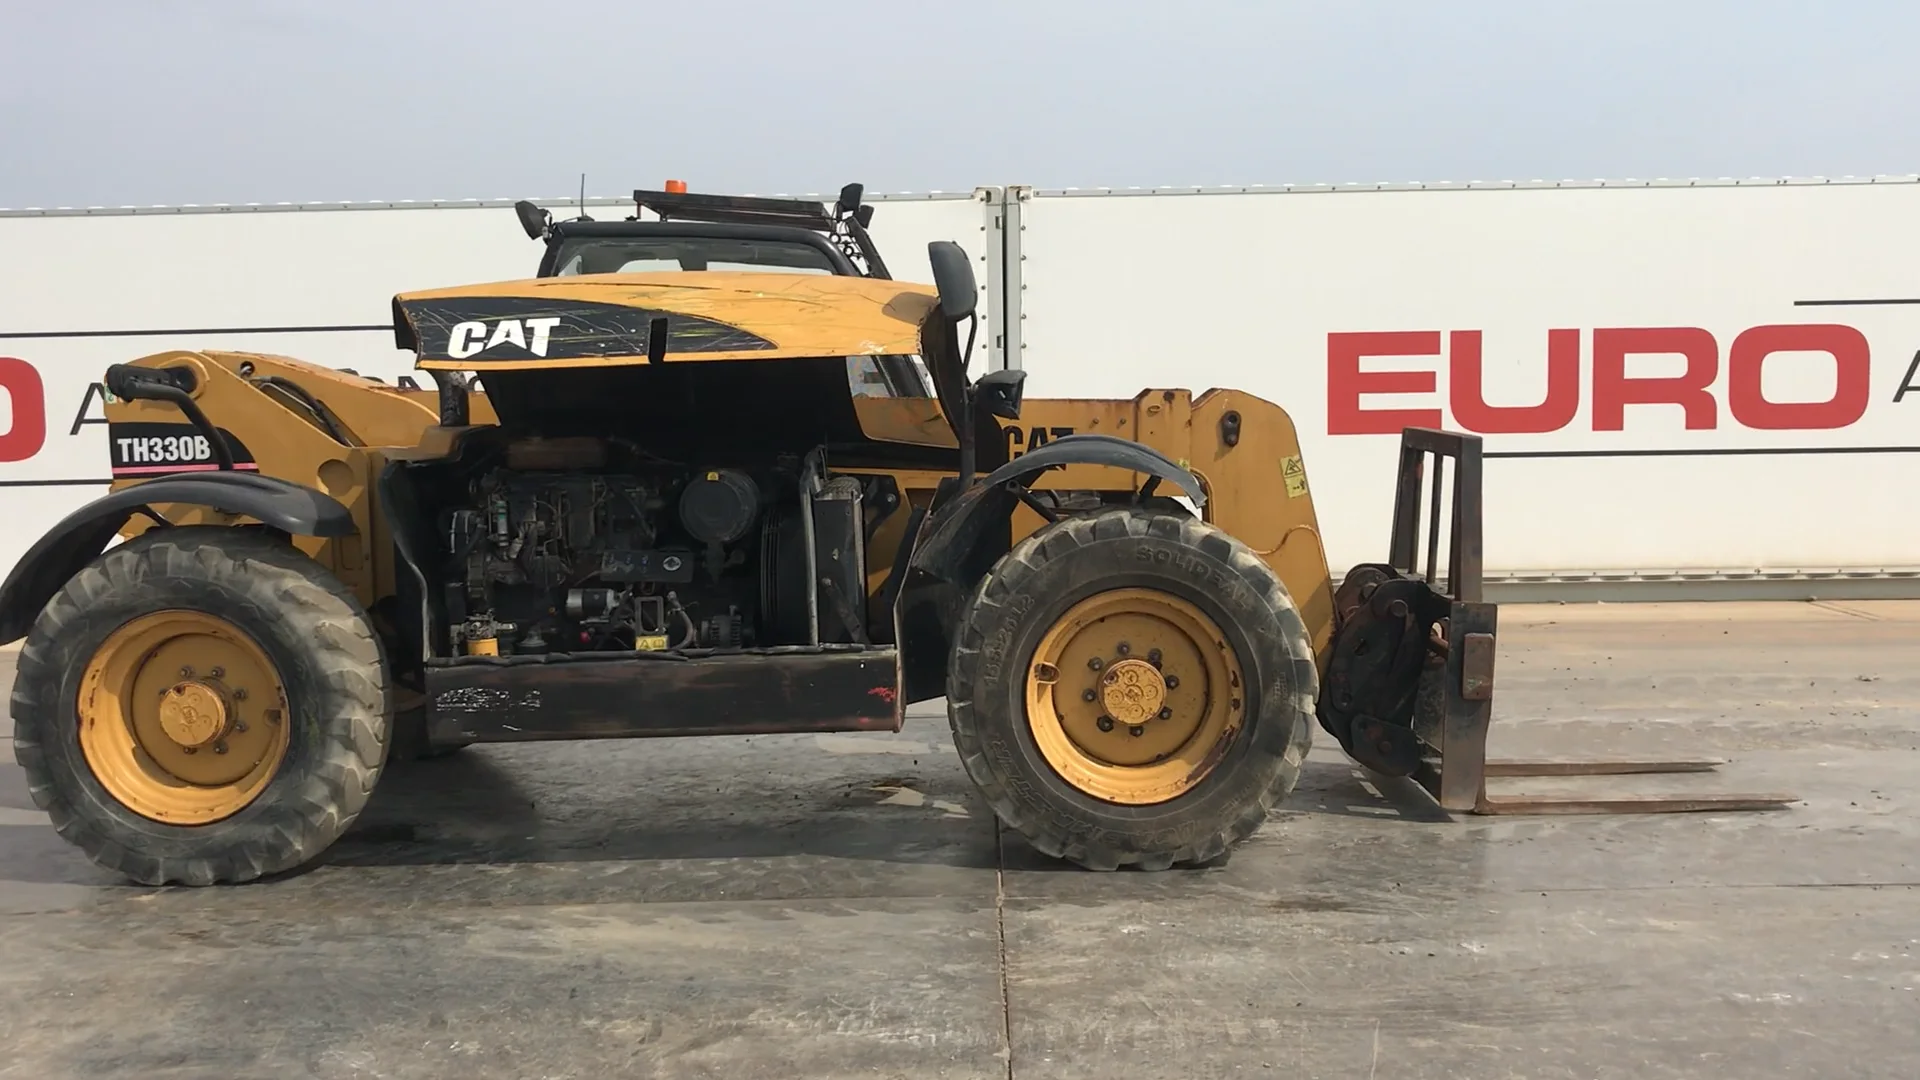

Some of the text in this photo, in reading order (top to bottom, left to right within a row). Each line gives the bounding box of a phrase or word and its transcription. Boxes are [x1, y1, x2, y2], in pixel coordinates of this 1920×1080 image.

[447, 317, 561, 359] CAT
[1327, 323, 1871, 436] EURO
[117, 435, 211, 463] TH330B
[1136, 545, 1254, 612] SOLIDEAL
